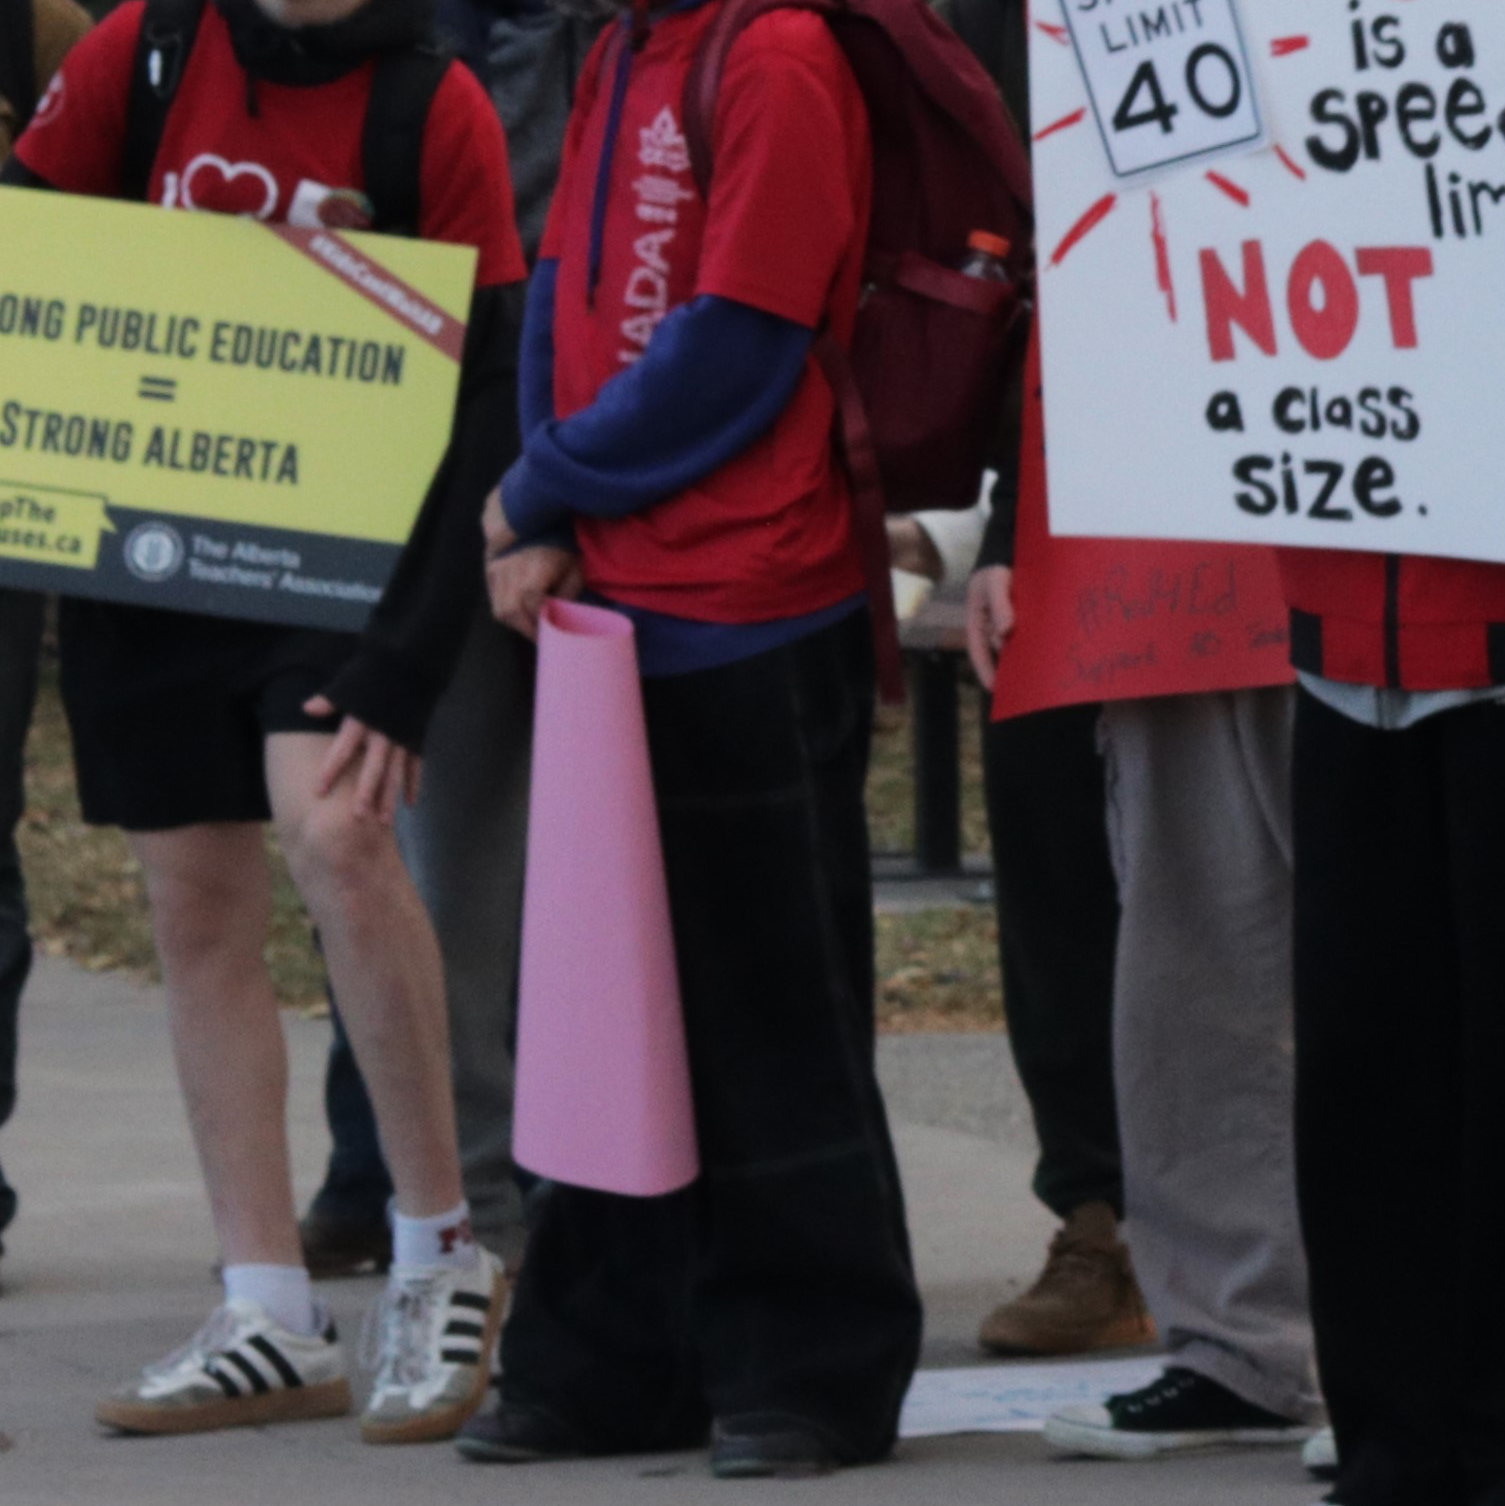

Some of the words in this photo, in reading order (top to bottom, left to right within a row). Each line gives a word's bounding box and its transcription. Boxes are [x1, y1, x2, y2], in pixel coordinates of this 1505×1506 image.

[1349, 0, 1404, 71] is
[1435, 21, 1476, 71] a
[1110, 42, 1242, 136] 40
[0, 294, 64, 342] ONG
[74, 303, 202, 360] PUBLIC
[209, 321, 406, 386] EDUCATION
[1199, 239, 1433, 362] NOT
[0, 399, 134, 464] STRONG
[142, 423, 299, 486] ALBERTA
[1206, 390, 1245, 434] a
[1272, 386, 1421, 442] class
[1233, 450, 1428, 522] size.
